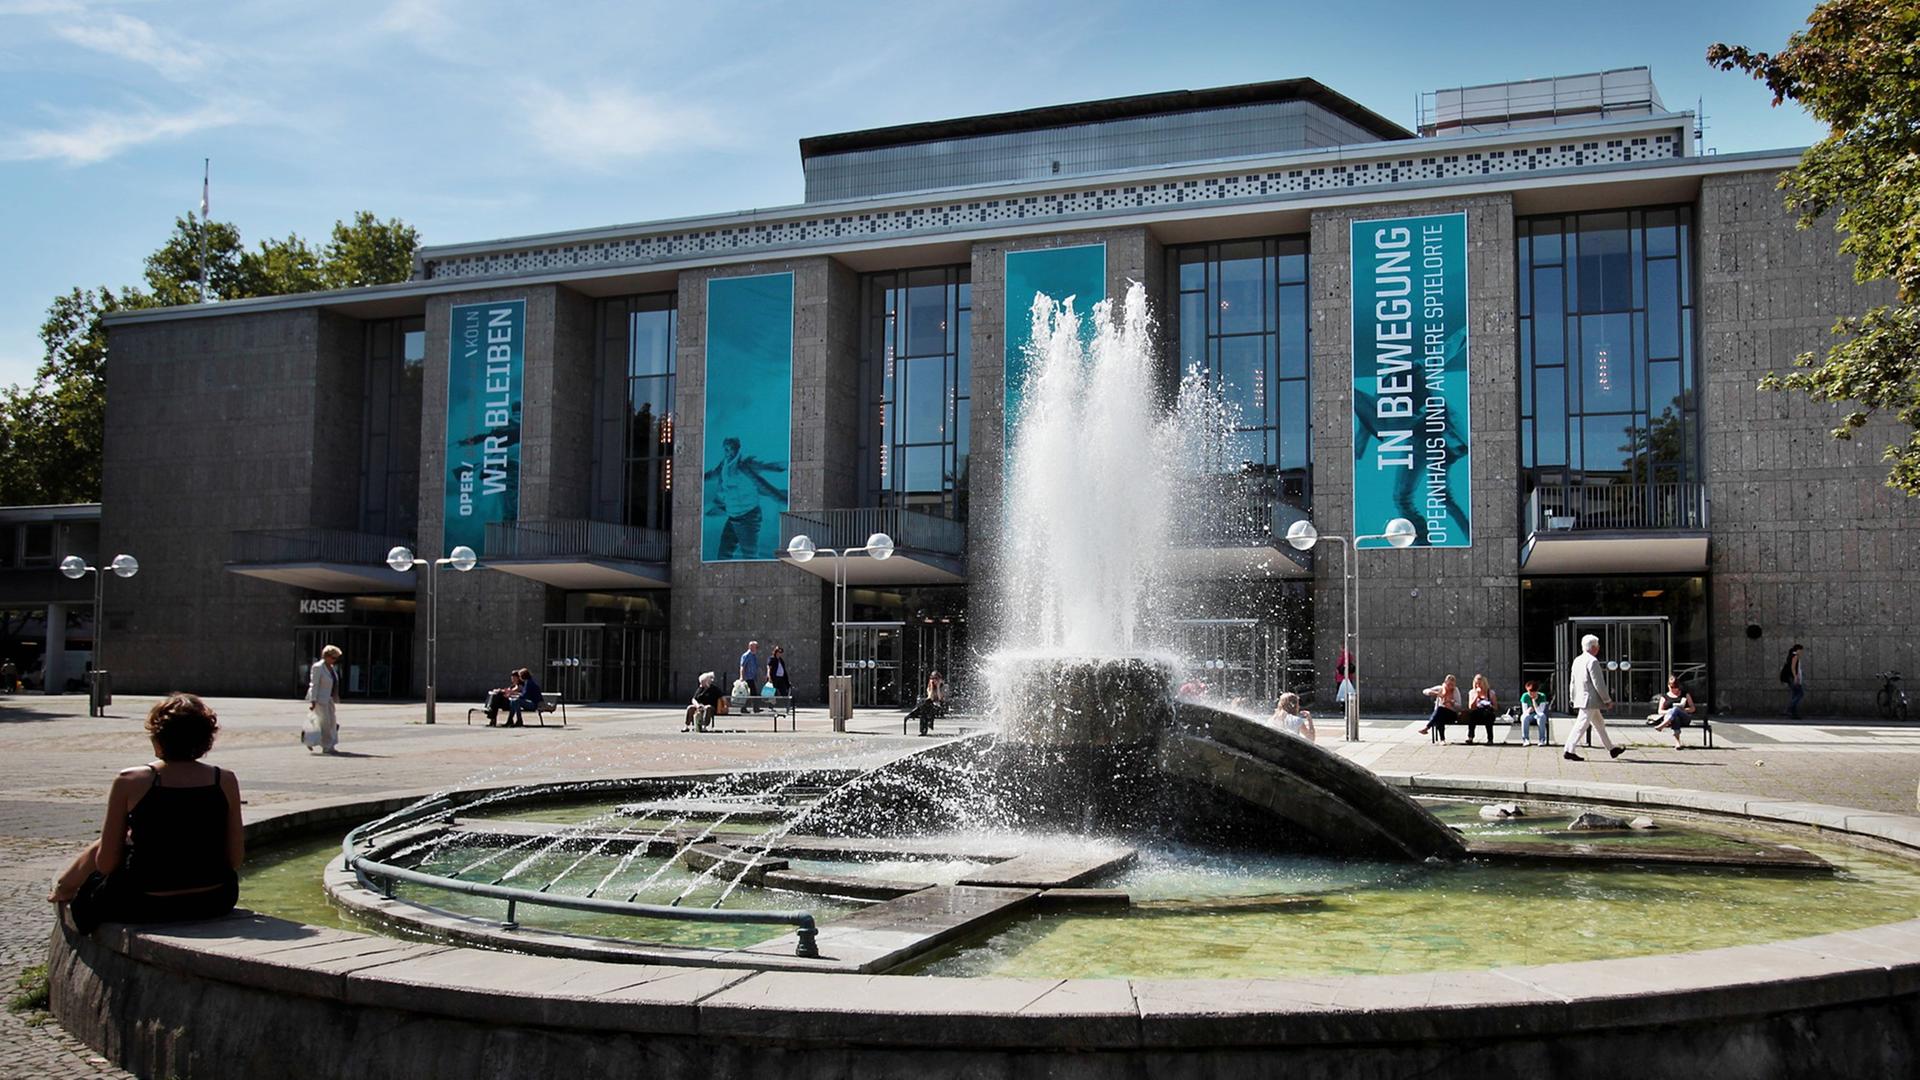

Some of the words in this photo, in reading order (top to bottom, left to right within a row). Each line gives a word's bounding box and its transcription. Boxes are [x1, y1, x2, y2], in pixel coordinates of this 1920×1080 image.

[1423, 224, 1443, 318] SPIELORTE
[1375, 227, 1412, 418] BEWEGUNG
[1424, 322, 1444, 391] ANDERE
[485, 308, 512, 427] BLEIBEN
[1425, 396, 1445, 432] UND
[483, 435, 508, 495] WIR
[1377, 429, 1413, 470] IN
[1426, 437, 1447, 543] OPERNHAUS
[300, 599, 344, 613] KASSE
